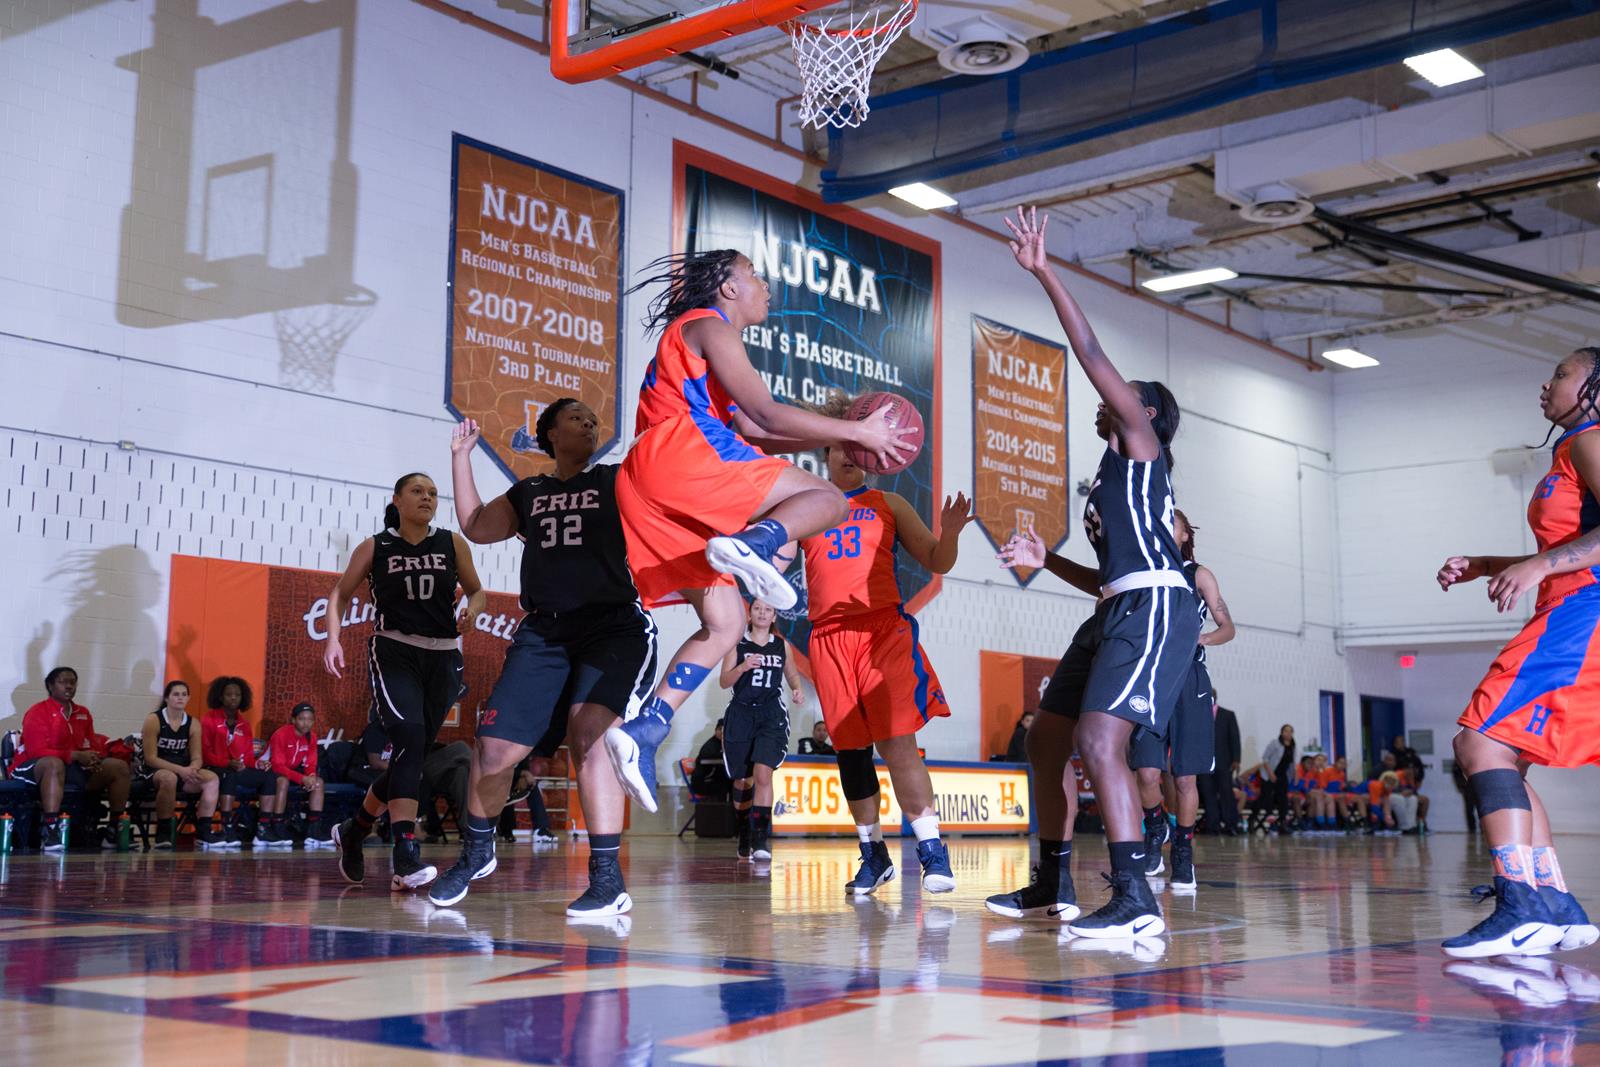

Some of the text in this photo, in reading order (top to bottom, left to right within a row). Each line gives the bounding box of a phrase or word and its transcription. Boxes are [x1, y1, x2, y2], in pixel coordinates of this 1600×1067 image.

[482, 182, 597, 249] NJCAA
[480, 230, 598, 279] MEN'S BASKETBALL
[752, 229, 882, 315] NJCAA
[461, 247, 613, 304] REGIONAL CHAMPIONSHIP
[467, 288, 605, 347] 2007-2008
[465, 325, 611, 375] NATIONAL TOURNAMENT
[795, 332, 903, 388] BASKETBALL
[499, 355, 582, 392] 3RD PLACE
[988, 349, 1055, 393] NJCAA
[986, 428, 1057, 465] 2014-2015
[530, 489, 600, 517] ERIE
[1001, 476, 1049, 500] 5TH PLACE
[540, 514, 583, 549] 32
[825, 526, 862, 561] 33
[387, 553, 447, 574] ERIE
[404, 574, 436, 601] 10
[751, 668, 772, 688] 21
[1525, 703, 1553, 737] H
[157, 737, 188, 750] ERIE
[784, 775, 990, 822] HOSS AIMANS
